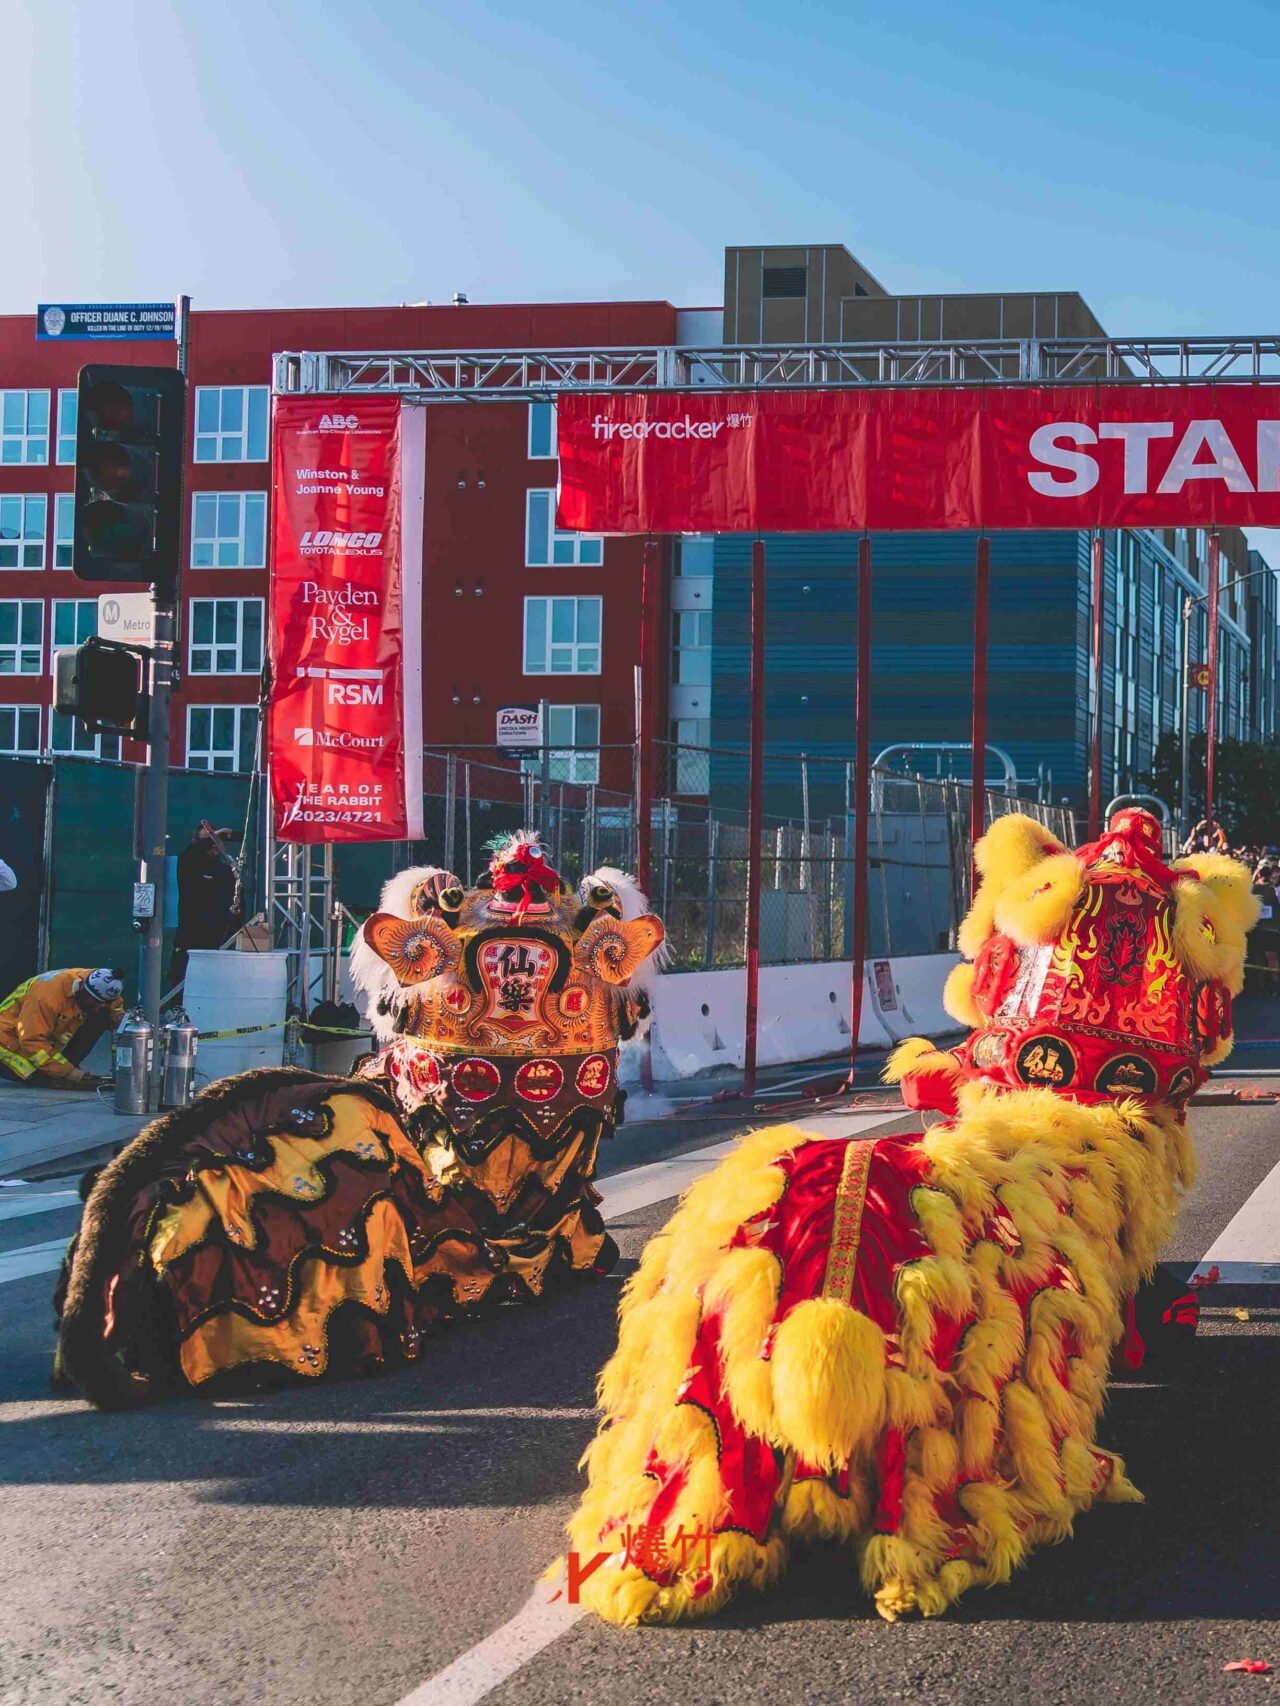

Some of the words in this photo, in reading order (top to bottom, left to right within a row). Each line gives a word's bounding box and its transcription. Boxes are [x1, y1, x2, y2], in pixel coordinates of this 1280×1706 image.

[70, 312, 102, 323] OFFICER
[103, 312, 129, 322] DUANE
[130, 312, 138, 322] C.
[139, 311, 174, 322] JOHNSON
[318, 415, 359, 429] ABC
[591, 414, 725, 440] firecracker
[296, 469, 347, 480] Winston
[351, 469, 359, 480] &
[296, 484, 342, 495] Joanne
[345, 484, 384, 496] Young
[299, 531, 383, 548] LONGO
[299, 547, 336, 555] TOYOTA
[336, 548, 383, 556] LEXUS
[302, 581, 379, 610] Payden
[331, 604, 356, 626] &
[123, 619, 151, 631] Metro
[310, 616, 370, 646] Rygel
[328, 683, 384, 705] RSM
[500, 714, 538, 725] DASH
[315, 731, 385, 748] McCourt
[295, 782, 350, 794] YEAR
[357, 784, 383, 794] OF
[296, 795, 323, 805] THE
[327, 796, 383, 806] RABBIT
[293, 810, 382, 823] 2023/4721
